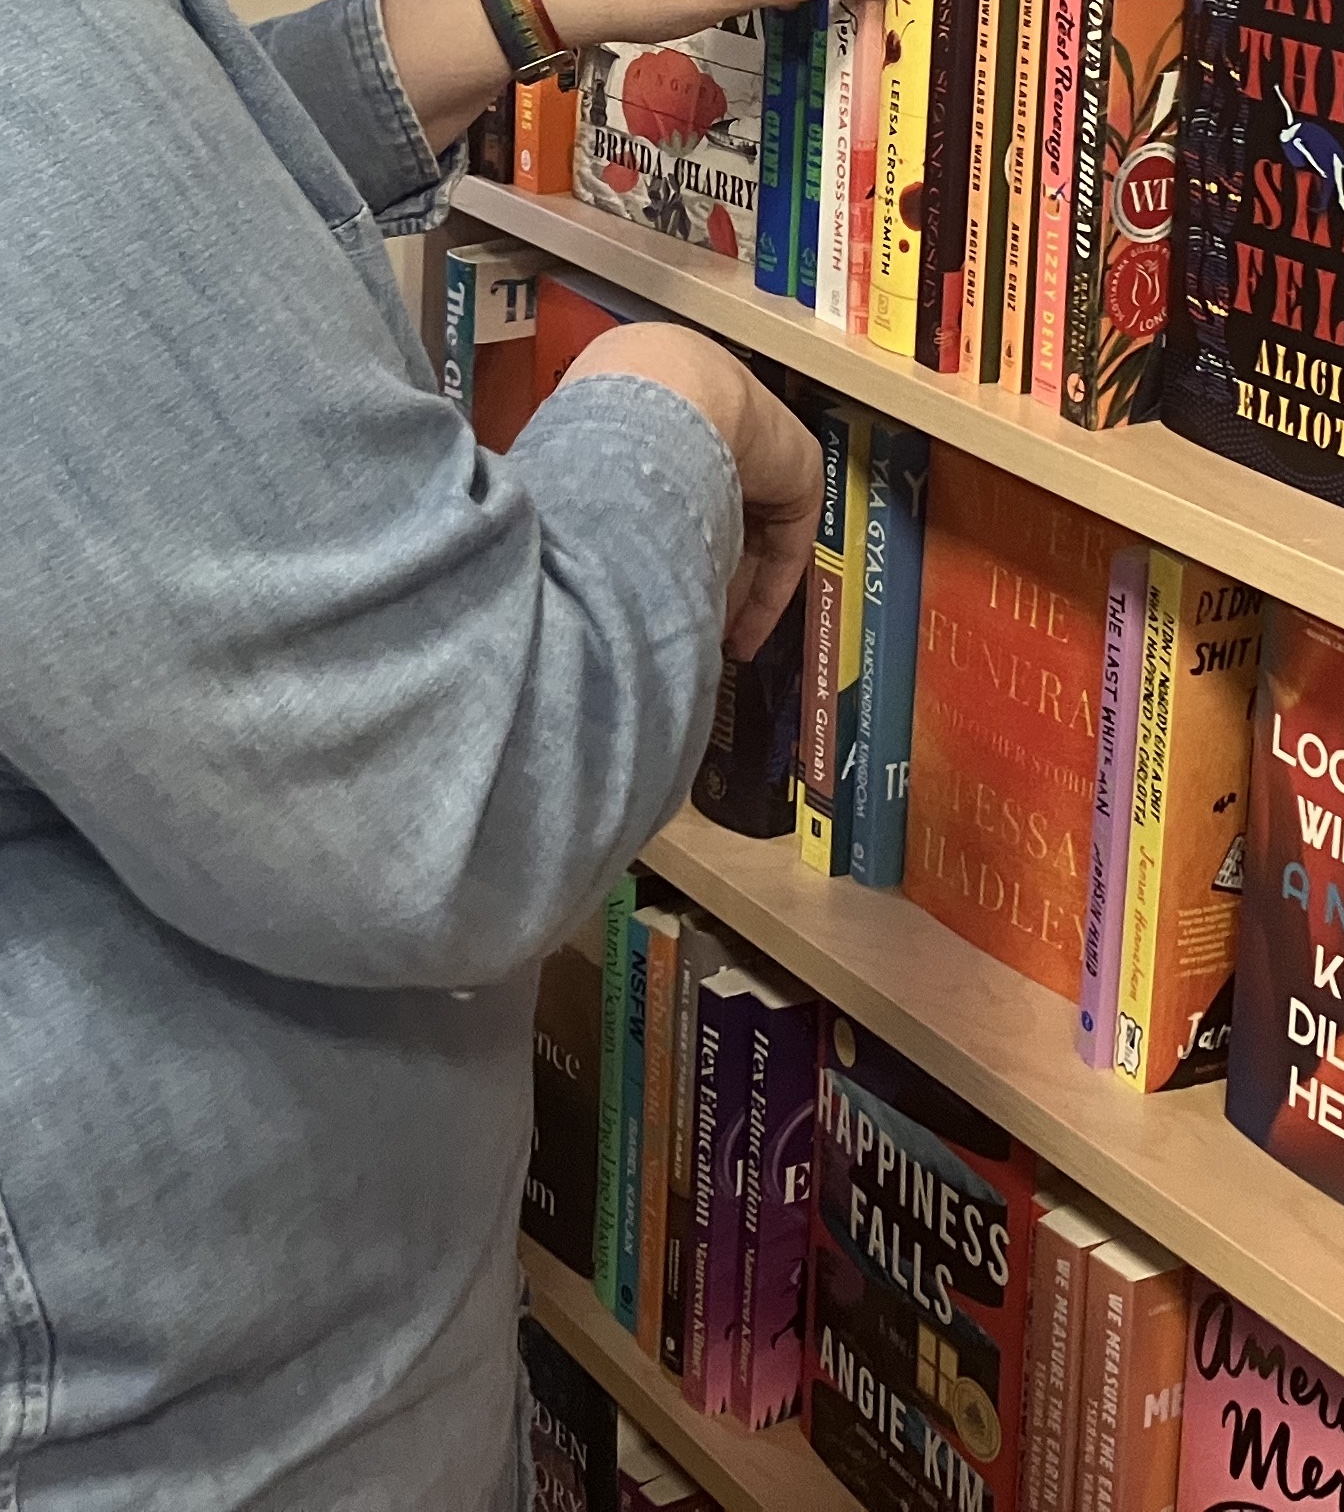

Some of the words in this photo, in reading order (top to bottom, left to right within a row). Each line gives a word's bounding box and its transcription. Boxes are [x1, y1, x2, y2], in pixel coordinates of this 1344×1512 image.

[837, 71, 852, 132] LEESA
[886, 79, 901, 136] LEESA
[593, 129, 664, 178] BRINDA
[674, 158, 757, 211] CHARRY
[831, 135, 849, 272] CROSS-SMITH
[880, 145, 898, 276] CROSS-SMITH
[1043, 232, 1061, 303] LIZZY
[1040, 311, 1056, 371] DENT
[822, 428, 842, 538] Afterlives
[987, 564, 1069, 644] THE
[1108, 593, 1126, 638] THE
[816, 577, 835, 701] Abdulrazak
[1104, 643, 1121, 702] LAST
[812, 709, 830, 782] Gurnah
[1101, 705, 1117, 766] WHITE
[1095, 772, 1111, 818] MAN
[1282, 861, 1311, 912] A
[629, 949, 648, 1048] NSFW
[699, 1024, 720, 1082] Hex
[752, 1029, 770, 1088] Hex
[696, 1084, 717, 1226] Education
[744, 1089, 768, 1233] Education
[818, 1067, 1011, 1287] HAPPINESS
[850, 1183, 954, 1326] FALLS
[1054, 1258, 1071, 1288] WE
[1048, 1291, 1069, 1385] MEASURE
[819, 1325, 906, 1452] ANGIE
[923, 1424, 984, 1512] KIM
[1045, 1387, 1064, 1428] THE
